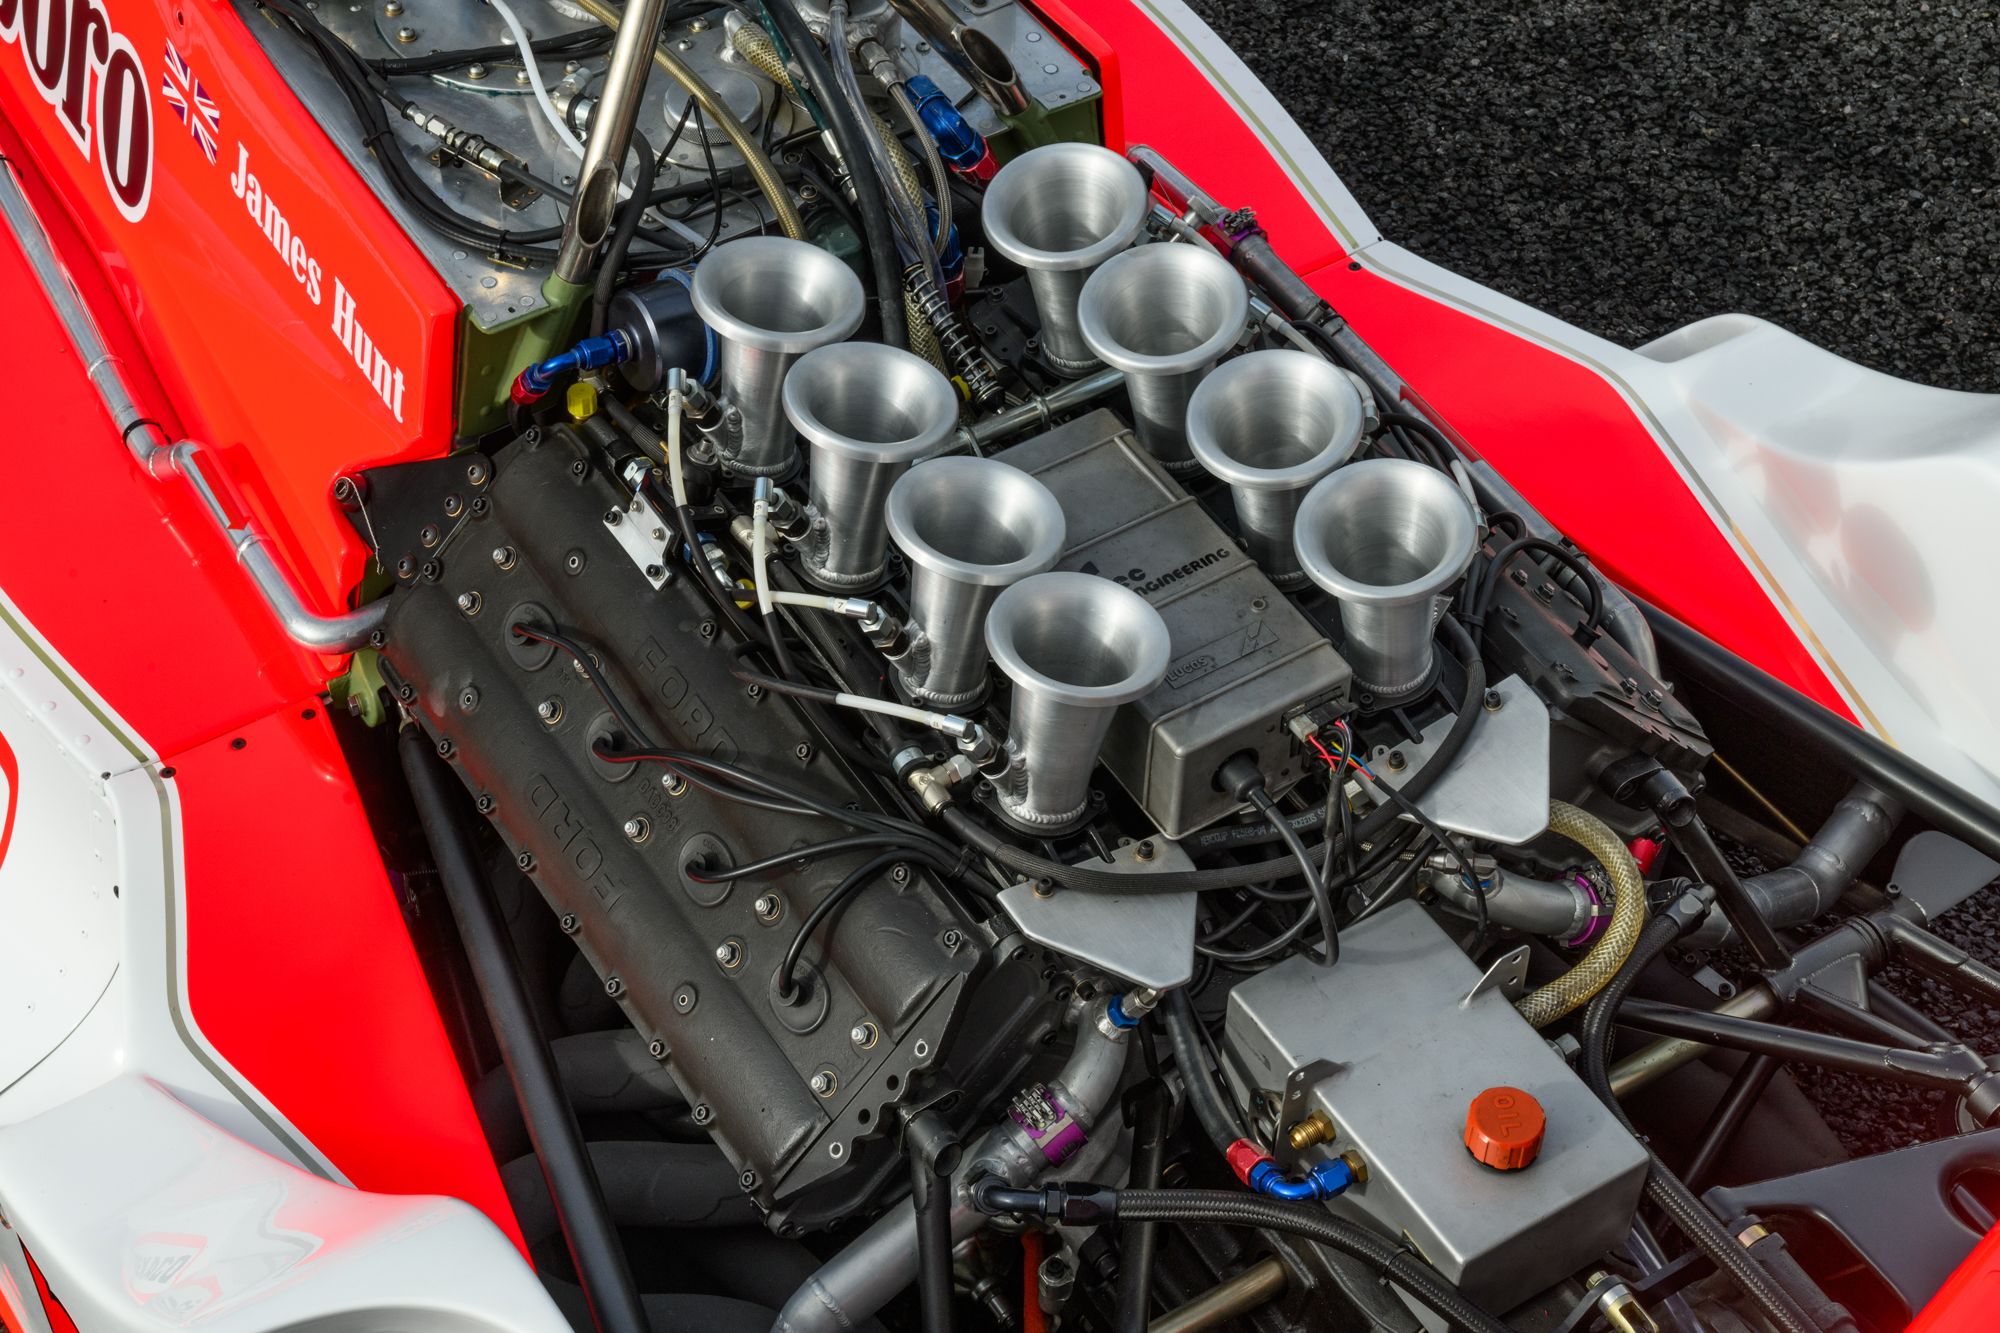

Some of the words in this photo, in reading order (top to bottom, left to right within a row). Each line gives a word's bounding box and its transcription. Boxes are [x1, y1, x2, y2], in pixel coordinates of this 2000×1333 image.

[0, 0, 153, 222] oro
[230, 141, 322, 306] James
[331, 275, 406, 424] Hunt
[633, 634, 740, 766] FORD
[523, 772, 624, 913] FORD
[1494, 1095, 1522, 1138] OIL
